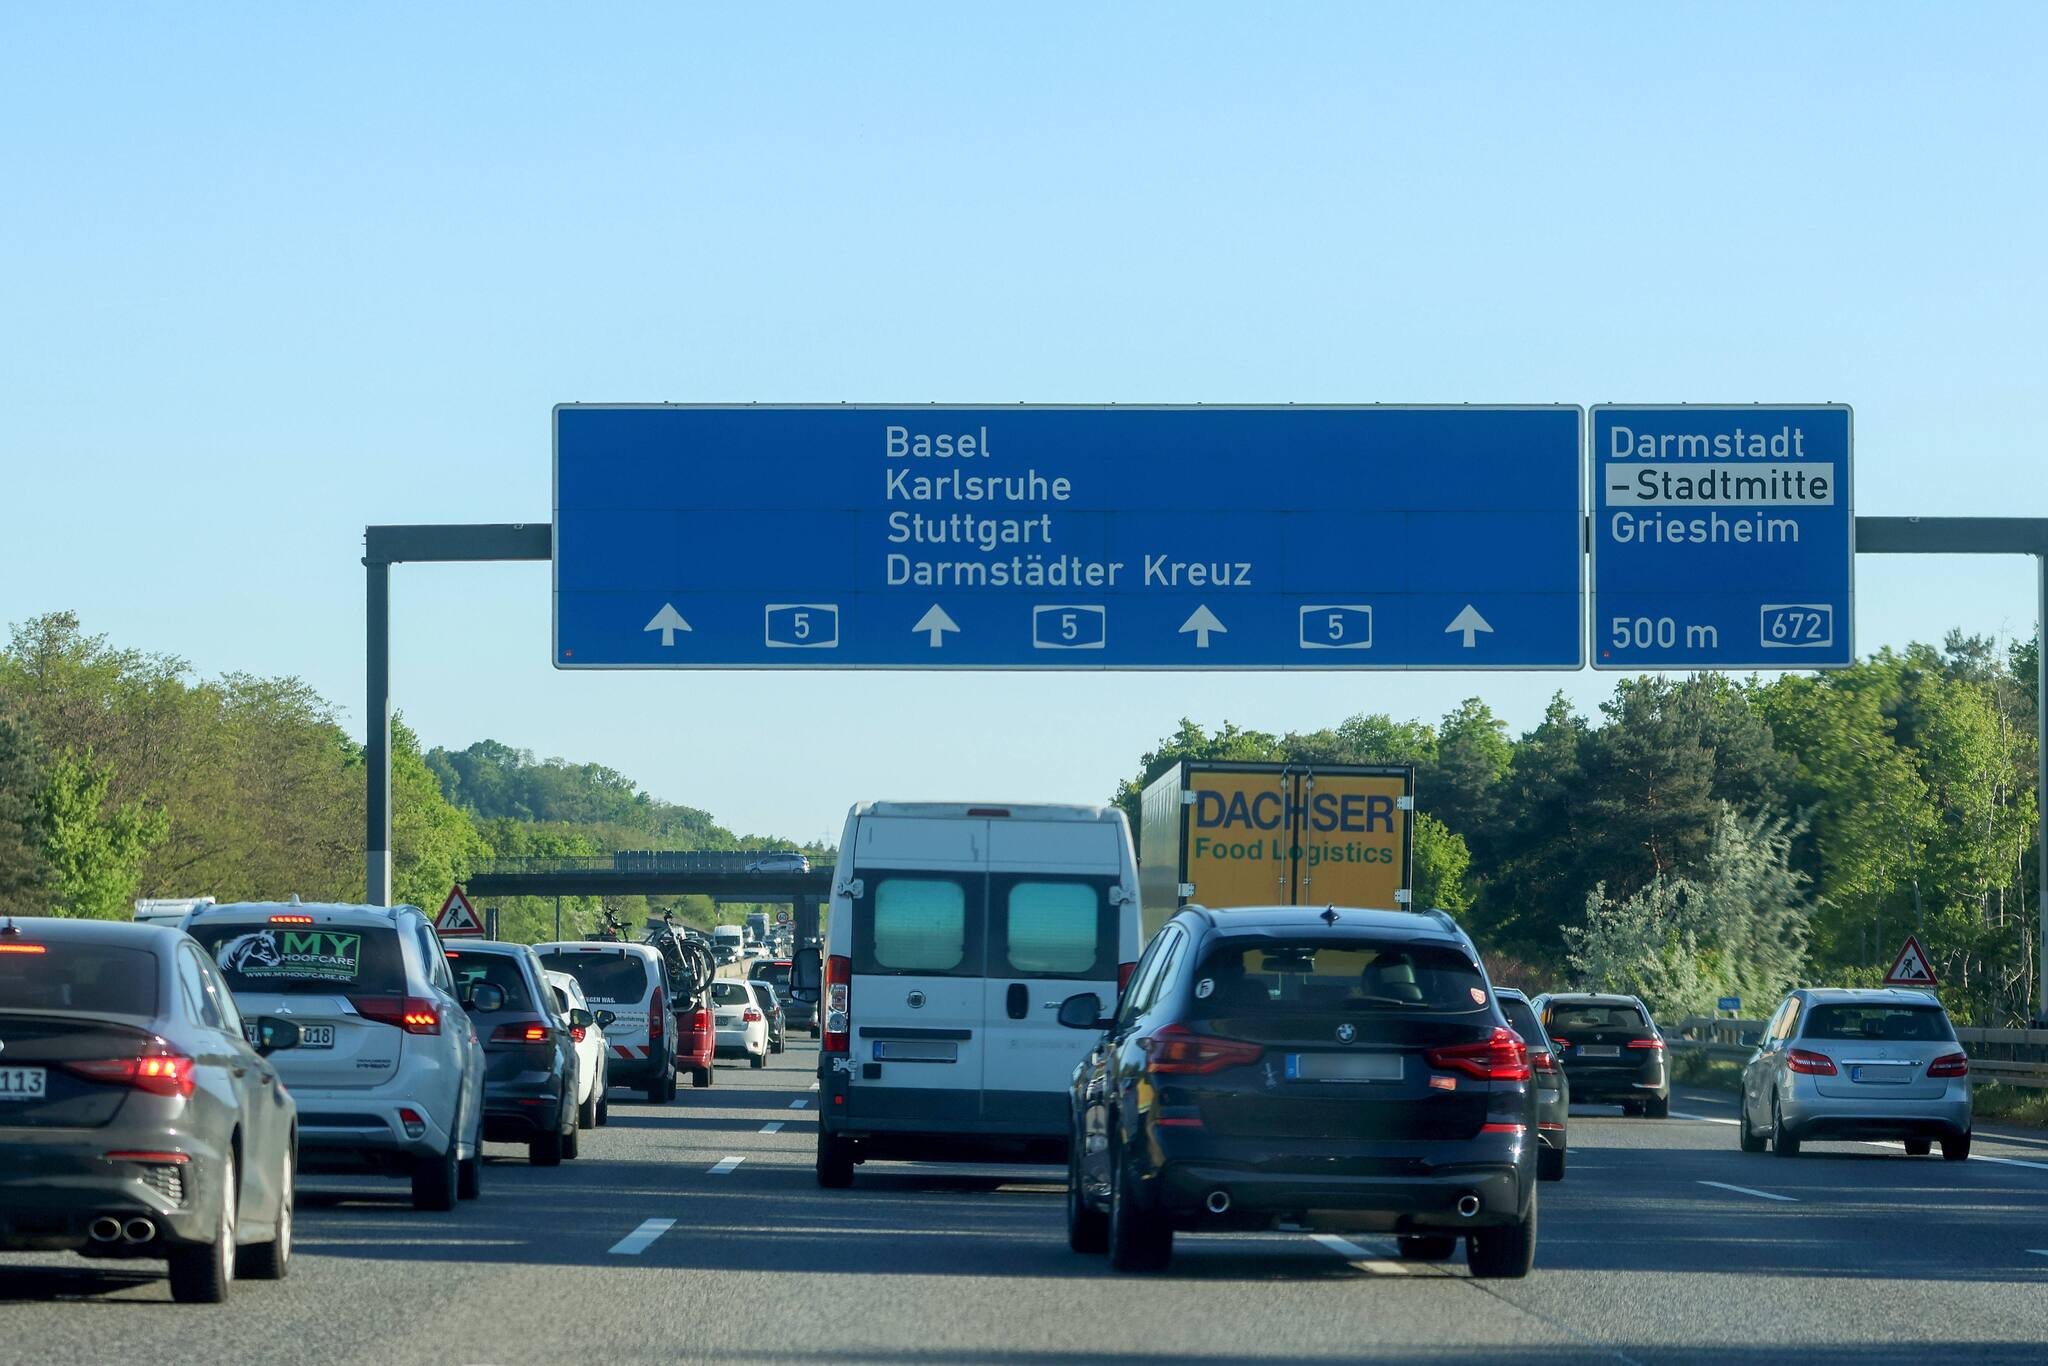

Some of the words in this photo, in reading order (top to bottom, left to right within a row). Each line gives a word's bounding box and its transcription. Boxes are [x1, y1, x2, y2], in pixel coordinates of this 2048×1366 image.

[886, 426, 990, 458] Basel
[1611, 426, 1804, 458] Darmstadt
[886, 469, 1071, 500] Karlsruhe
[887, 511, 1052, 551] Stuttgart
[1611, 511, 1799, 543] Griesheim
[887, 553, 1124, 586] Darmstädter
[1144, 554, 1251, 586] Kreuz
[794, 614, 810, 639] 5
[1062, 614, 1077, 640] 5
[1328, 614, 1344, 640] 5
[1611, 617, 1676, 649] 500
[1686, 624, 1718, 648] m
[1771, 613, 1822, 639] 672
[1196, 790, 1394, 833] DACHSER
[1196, 837, 1264, 860] Food
[1272, 839, 1393, 866] Logistics
[280, 953, 356, 966] HOOFCARE
[283, 931, 359, 957] MY
